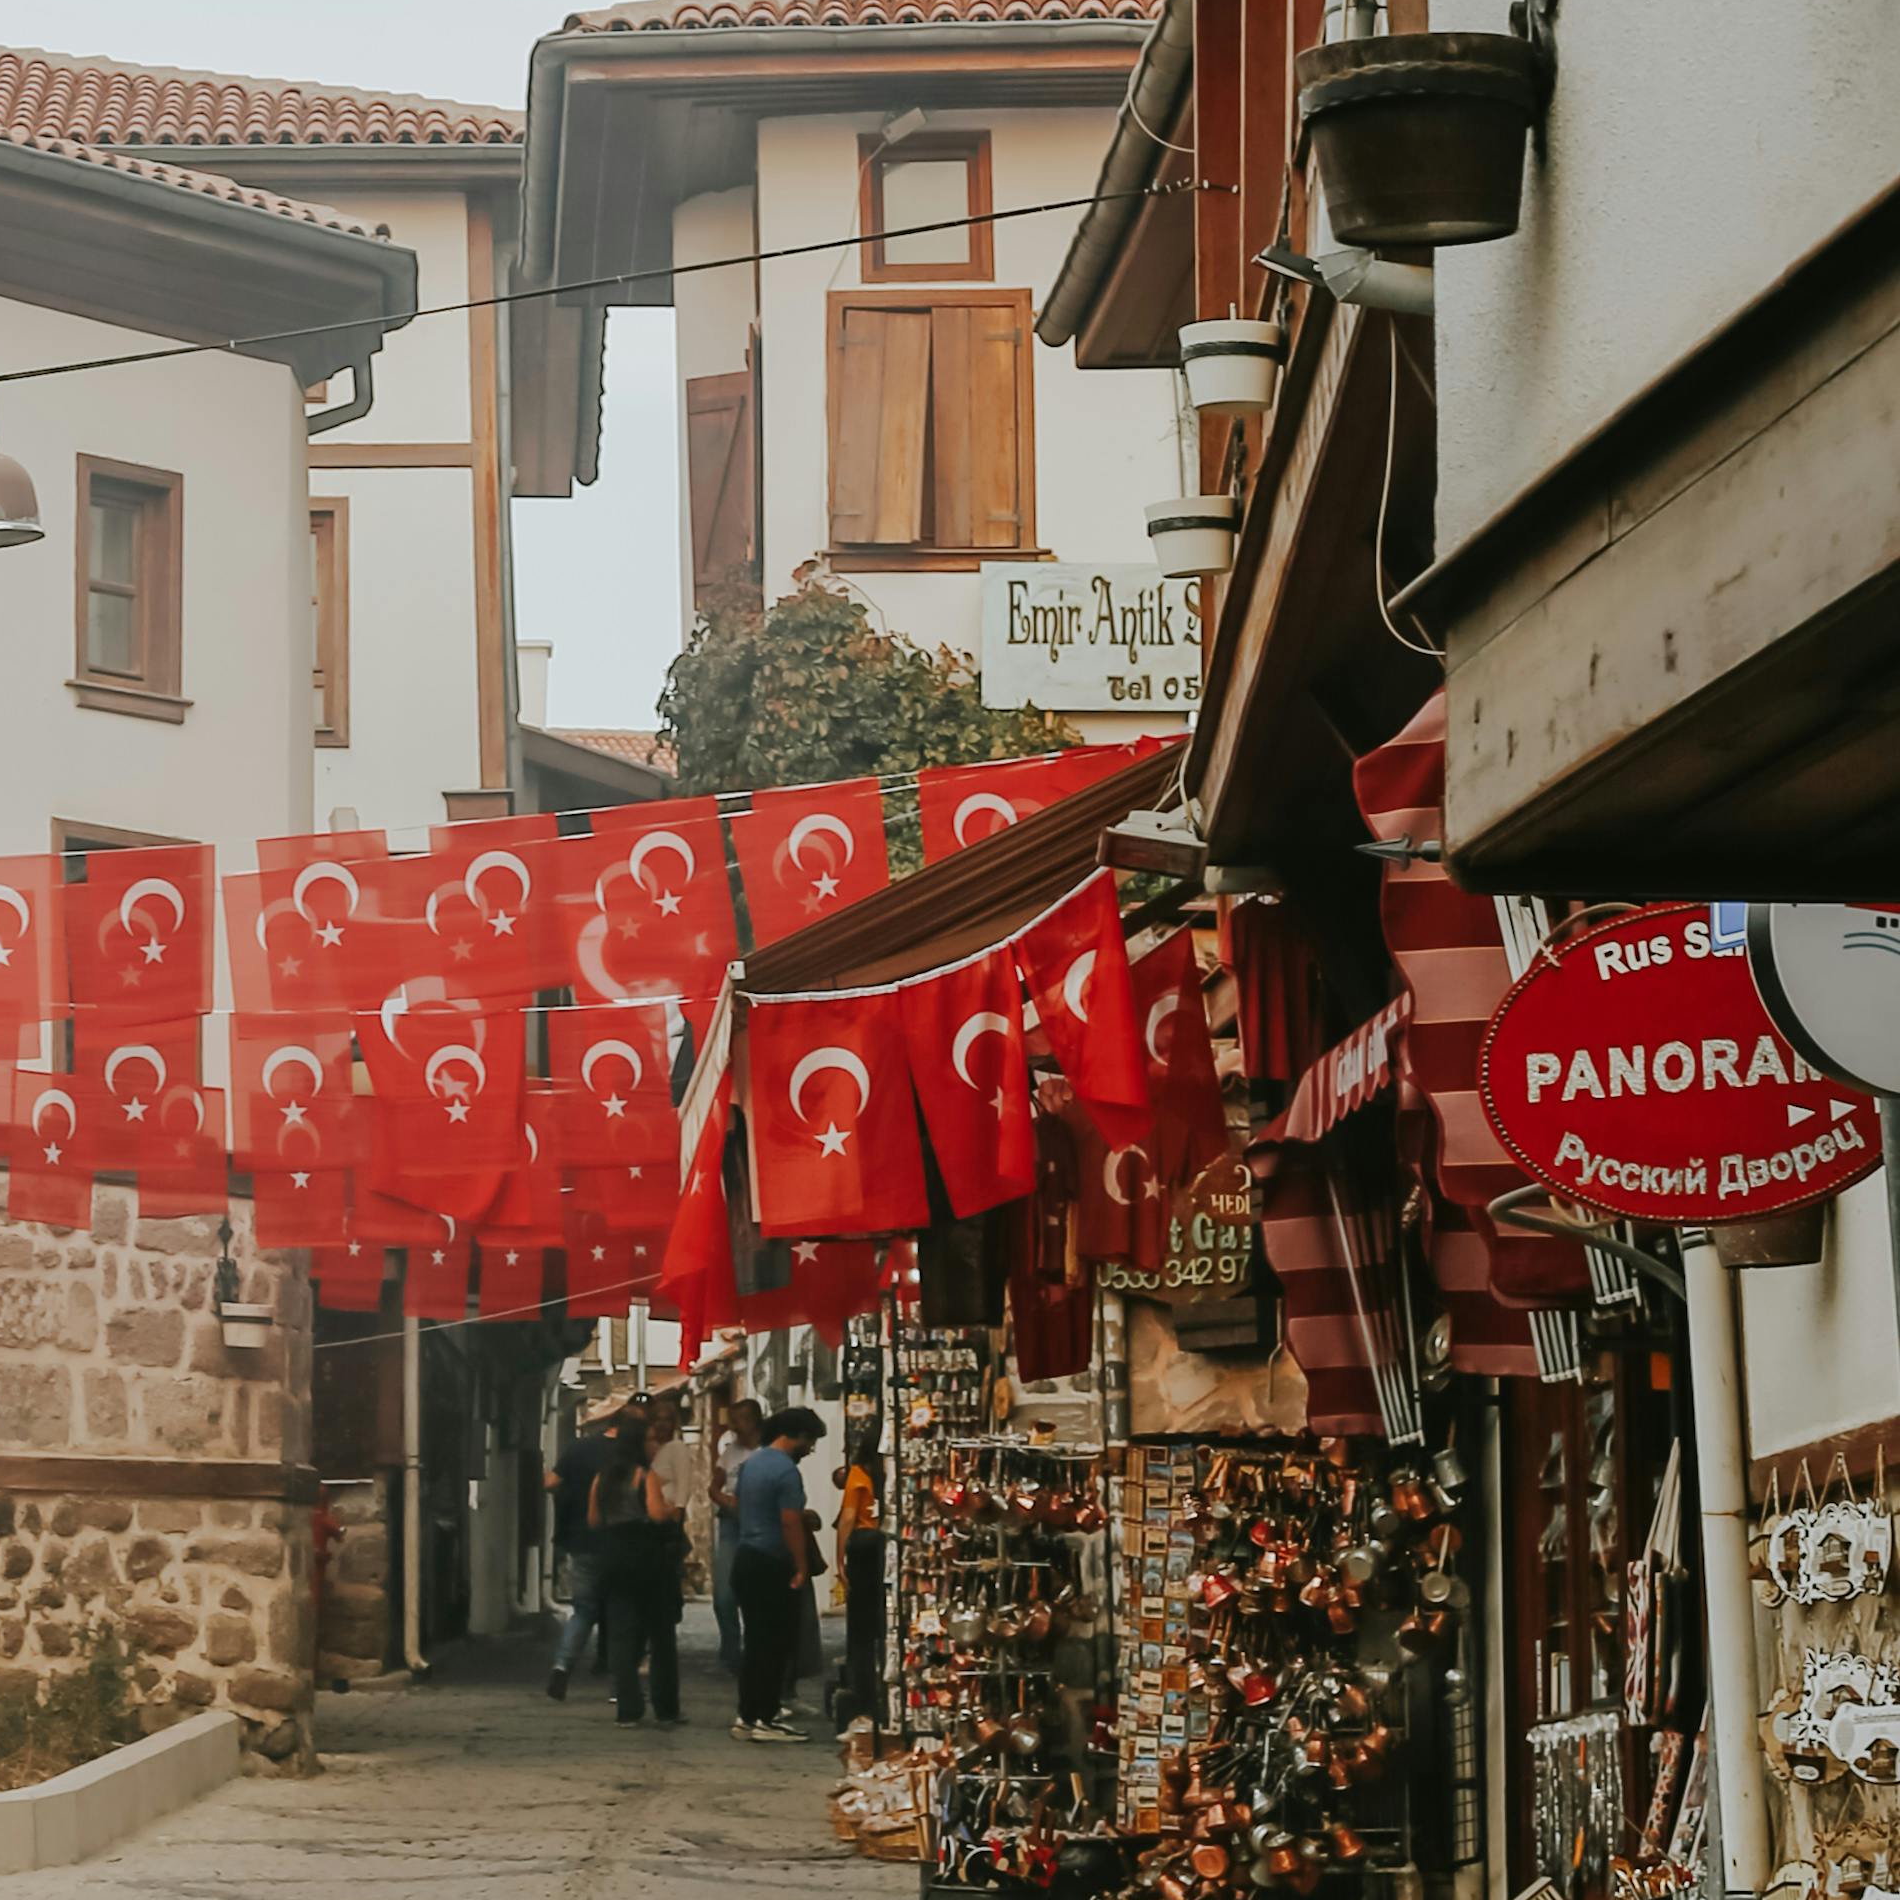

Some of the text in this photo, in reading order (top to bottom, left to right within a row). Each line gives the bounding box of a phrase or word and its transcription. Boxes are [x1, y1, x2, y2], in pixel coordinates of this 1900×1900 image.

[1006, 580, 1081, 664] Emir
[1088, 575, 1175, 664] Antik
[1106, 675, 1151, 701] Tel
[1593, 932, 1674, 981] Rus
[1554, 1119, 1867, 1201] Русский Дворец
[1165, 1256, 1213, 1288] 342
